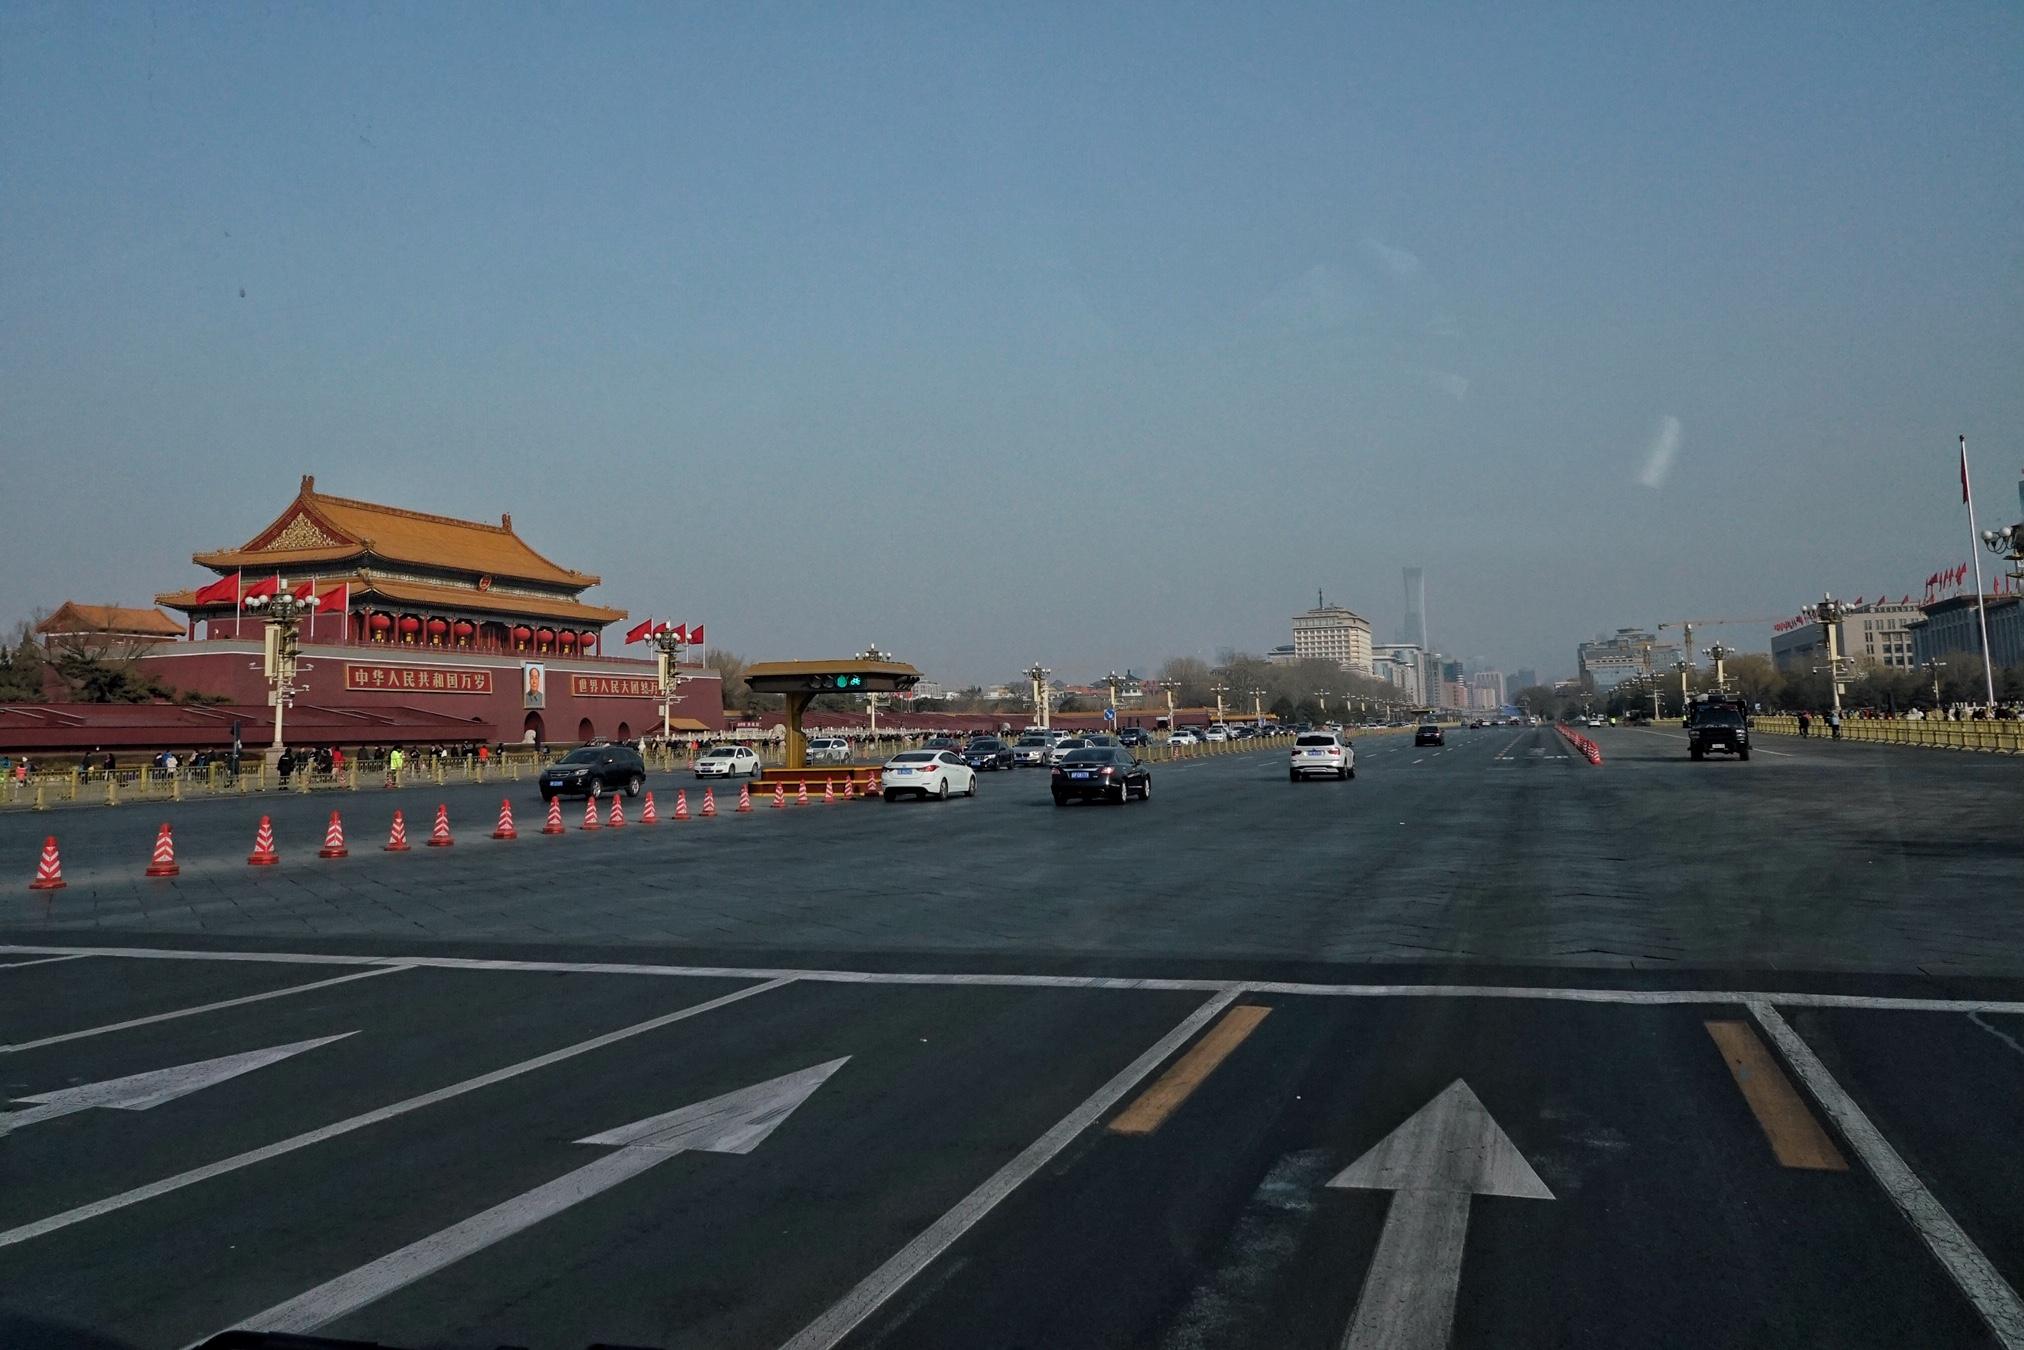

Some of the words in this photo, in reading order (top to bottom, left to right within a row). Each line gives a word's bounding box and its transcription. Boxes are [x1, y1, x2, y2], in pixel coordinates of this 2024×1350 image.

[355, 668, 485, 690] 中华人民共和国万岁
[579, 678, 665, 695] 世界人民大团结万
